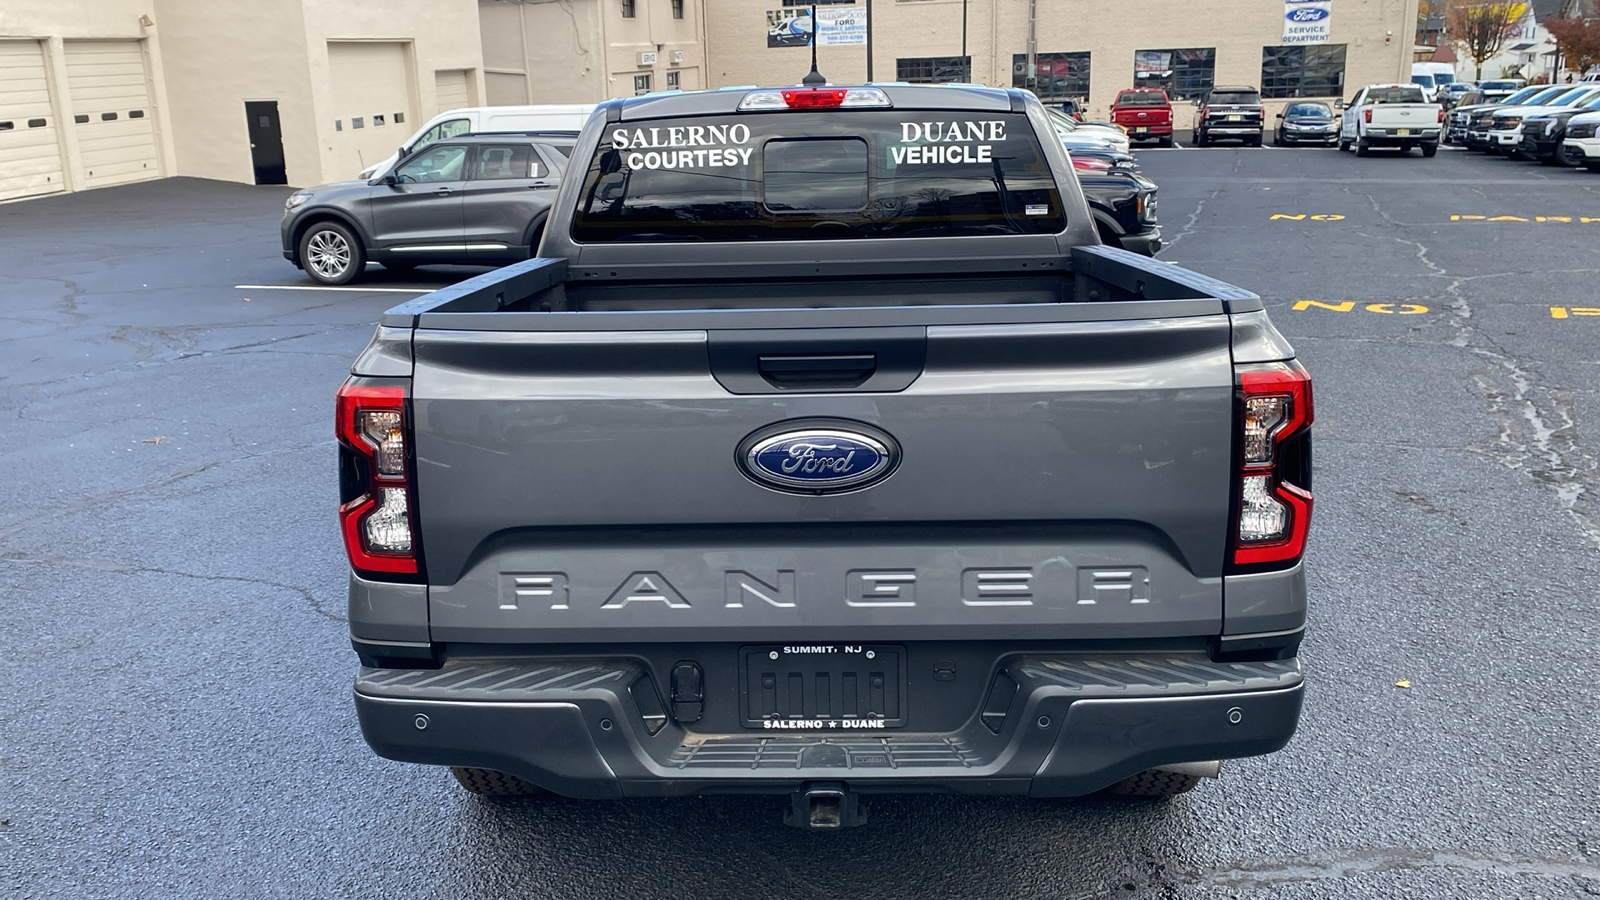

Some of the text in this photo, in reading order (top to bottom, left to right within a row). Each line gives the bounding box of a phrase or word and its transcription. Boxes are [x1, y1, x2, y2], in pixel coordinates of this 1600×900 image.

[1288, 26, 1325, 34] SERVICE
[612, 120, 1007, 150] SALERNO DUANE
[627, 145, 992, 170] COURTESY VEHICLE
[1292, 300, 1429, 315] NO
[498, 565, 1151, 610] RANGER
[783, 645, 862, 654] SUMMIT, NJ
[763, 720, 885, 729] SALERNO DUANE
